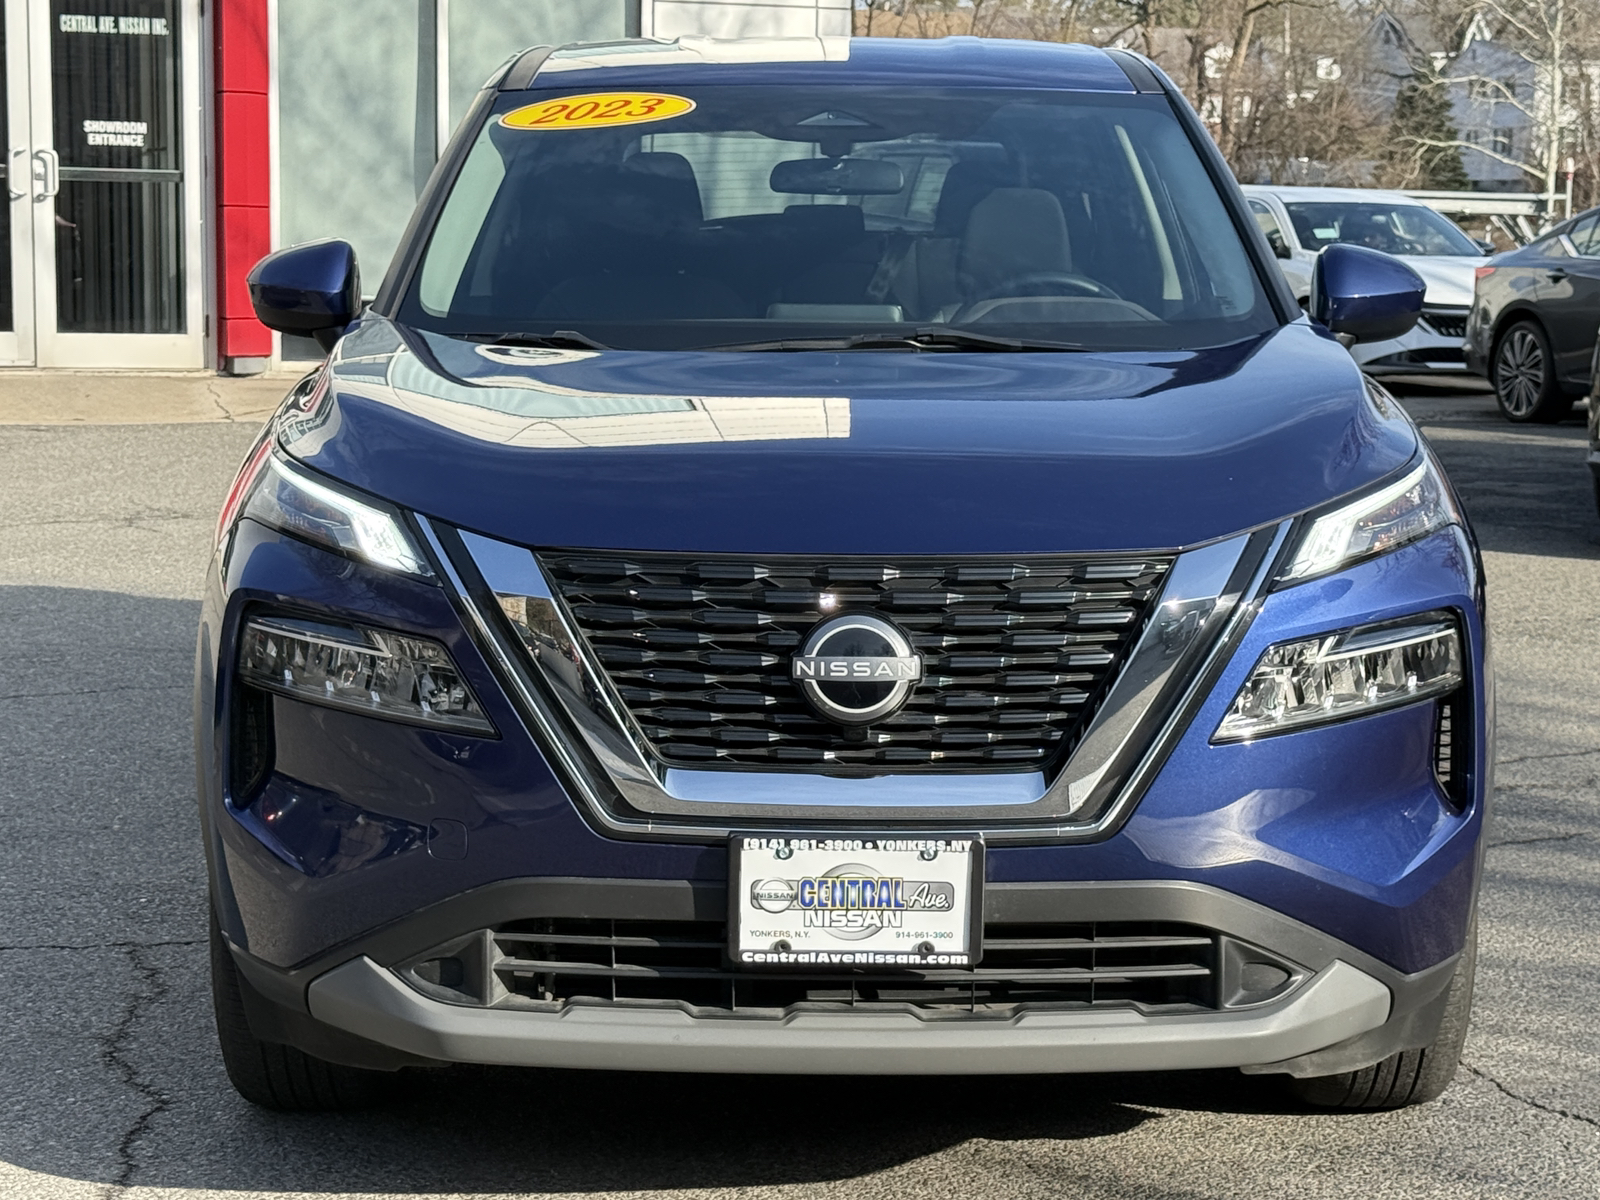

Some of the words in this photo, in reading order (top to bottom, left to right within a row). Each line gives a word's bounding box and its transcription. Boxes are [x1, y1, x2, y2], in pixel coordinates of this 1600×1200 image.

[59, 14, 98, 33] CENTRAL
[98, 15, 118, 34] AVE.
[118, 16, 150, 35] NISSAN
[151, 17, 170, 36] INC.
[529, 98, 665, 125] 2023
[83, 120, 148, 134] SHOWROOM
[87, 133, 144, 147] ENTRANCE
[796, 661, 917, 677] NISSAN
[756, 892, 794, 900] NISSAN
[799, 877, 906, 910] CENTRAL
[908, 882, 950, 909] Ave.
[804, 910, 902, 928] NISSAN
[749, 930, 793, 939] YONKERS,
[895, 931, 954, 939] 914-961-3900
[741, 952, 969, 965] CentralAveNissan.com
